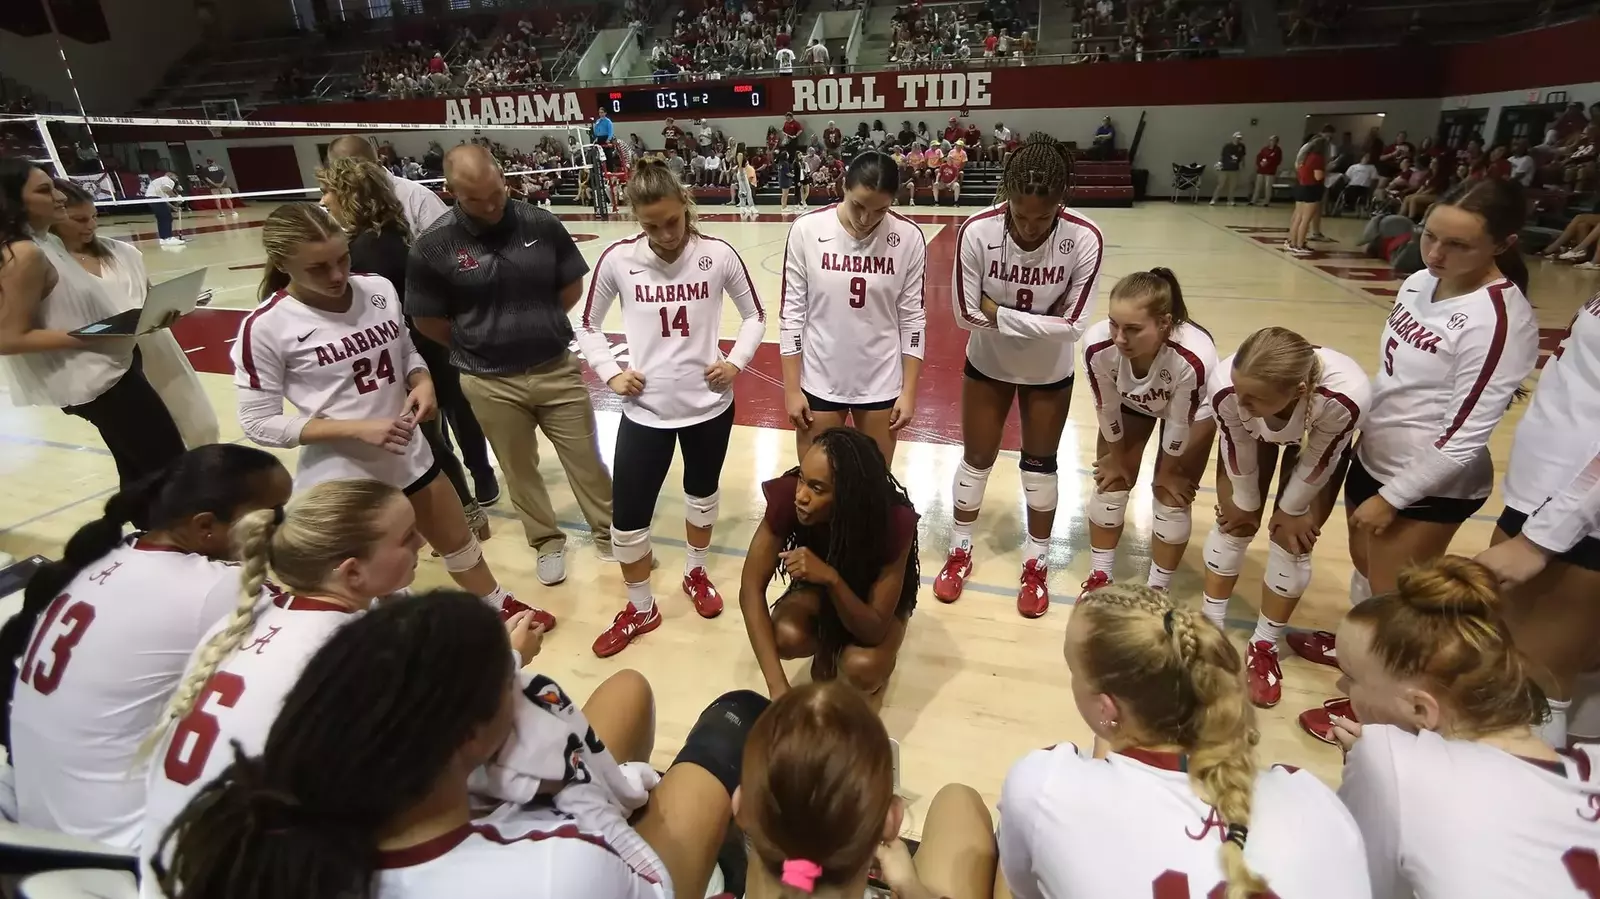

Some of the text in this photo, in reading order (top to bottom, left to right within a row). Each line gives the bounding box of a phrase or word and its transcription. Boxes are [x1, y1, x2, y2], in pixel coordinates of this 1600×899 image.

[612, 99, 621, 113] 0
[656, 92, 688, 109] 0:51
[702, 93, 709, 104] 2
[751, 92, 759, 106] 0
[792, 71, 992, 112] ROLL TIDE
[445, 91, 584, 125] ALABAMA
[1059, 240, 1074, 253] SEC
[821, 252, 895, 275] ALABAMA
[988, 260, 1065, 286] ALABAMA
[635, 281, 709, 303] ALABAMA
[849, 277, 867, 309] 9
[1016, 288, 1033, 312] 8
[659, 305, 690, 337] 14
[1387, 302, 1442, 354] ALABAMA
[314, 319, 401, 367] ALABAMA
[910, 331, 920, 348] TIDE
[352, 348, 397, 395] 24
[1384, 336, 1399, 377] 5
[20, 592, 96, 696] 13
[164, 670, 246, 786] 6
